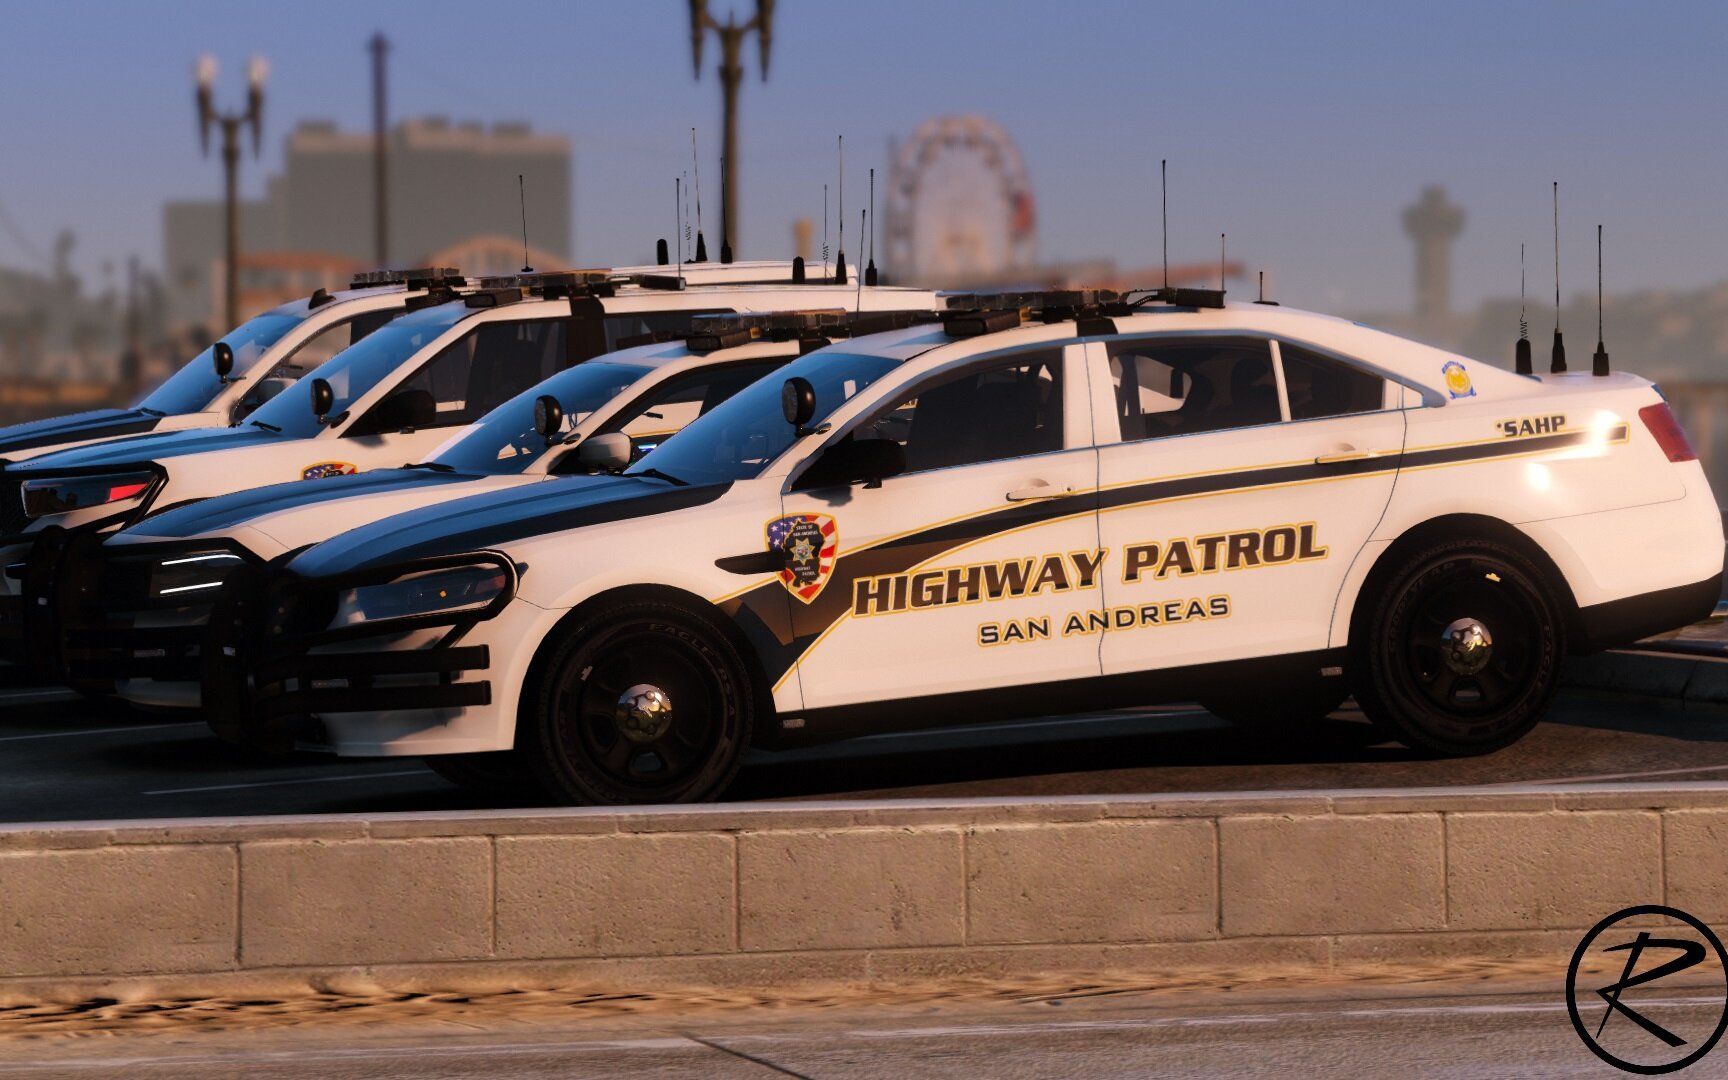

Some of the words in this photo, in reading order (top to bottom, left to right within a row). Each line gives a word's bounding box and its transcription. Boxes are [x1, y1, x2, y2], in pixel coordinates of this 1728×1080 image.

[1503, 415, 1566, 438] SAHP
[853, 549, 1106, 617] HIGHWAY
[1122, 523, 1328, 582] PATROL
[979, 616, 1049, 645] SAN
[1064, 596, 1230, 635] ANDREAS
